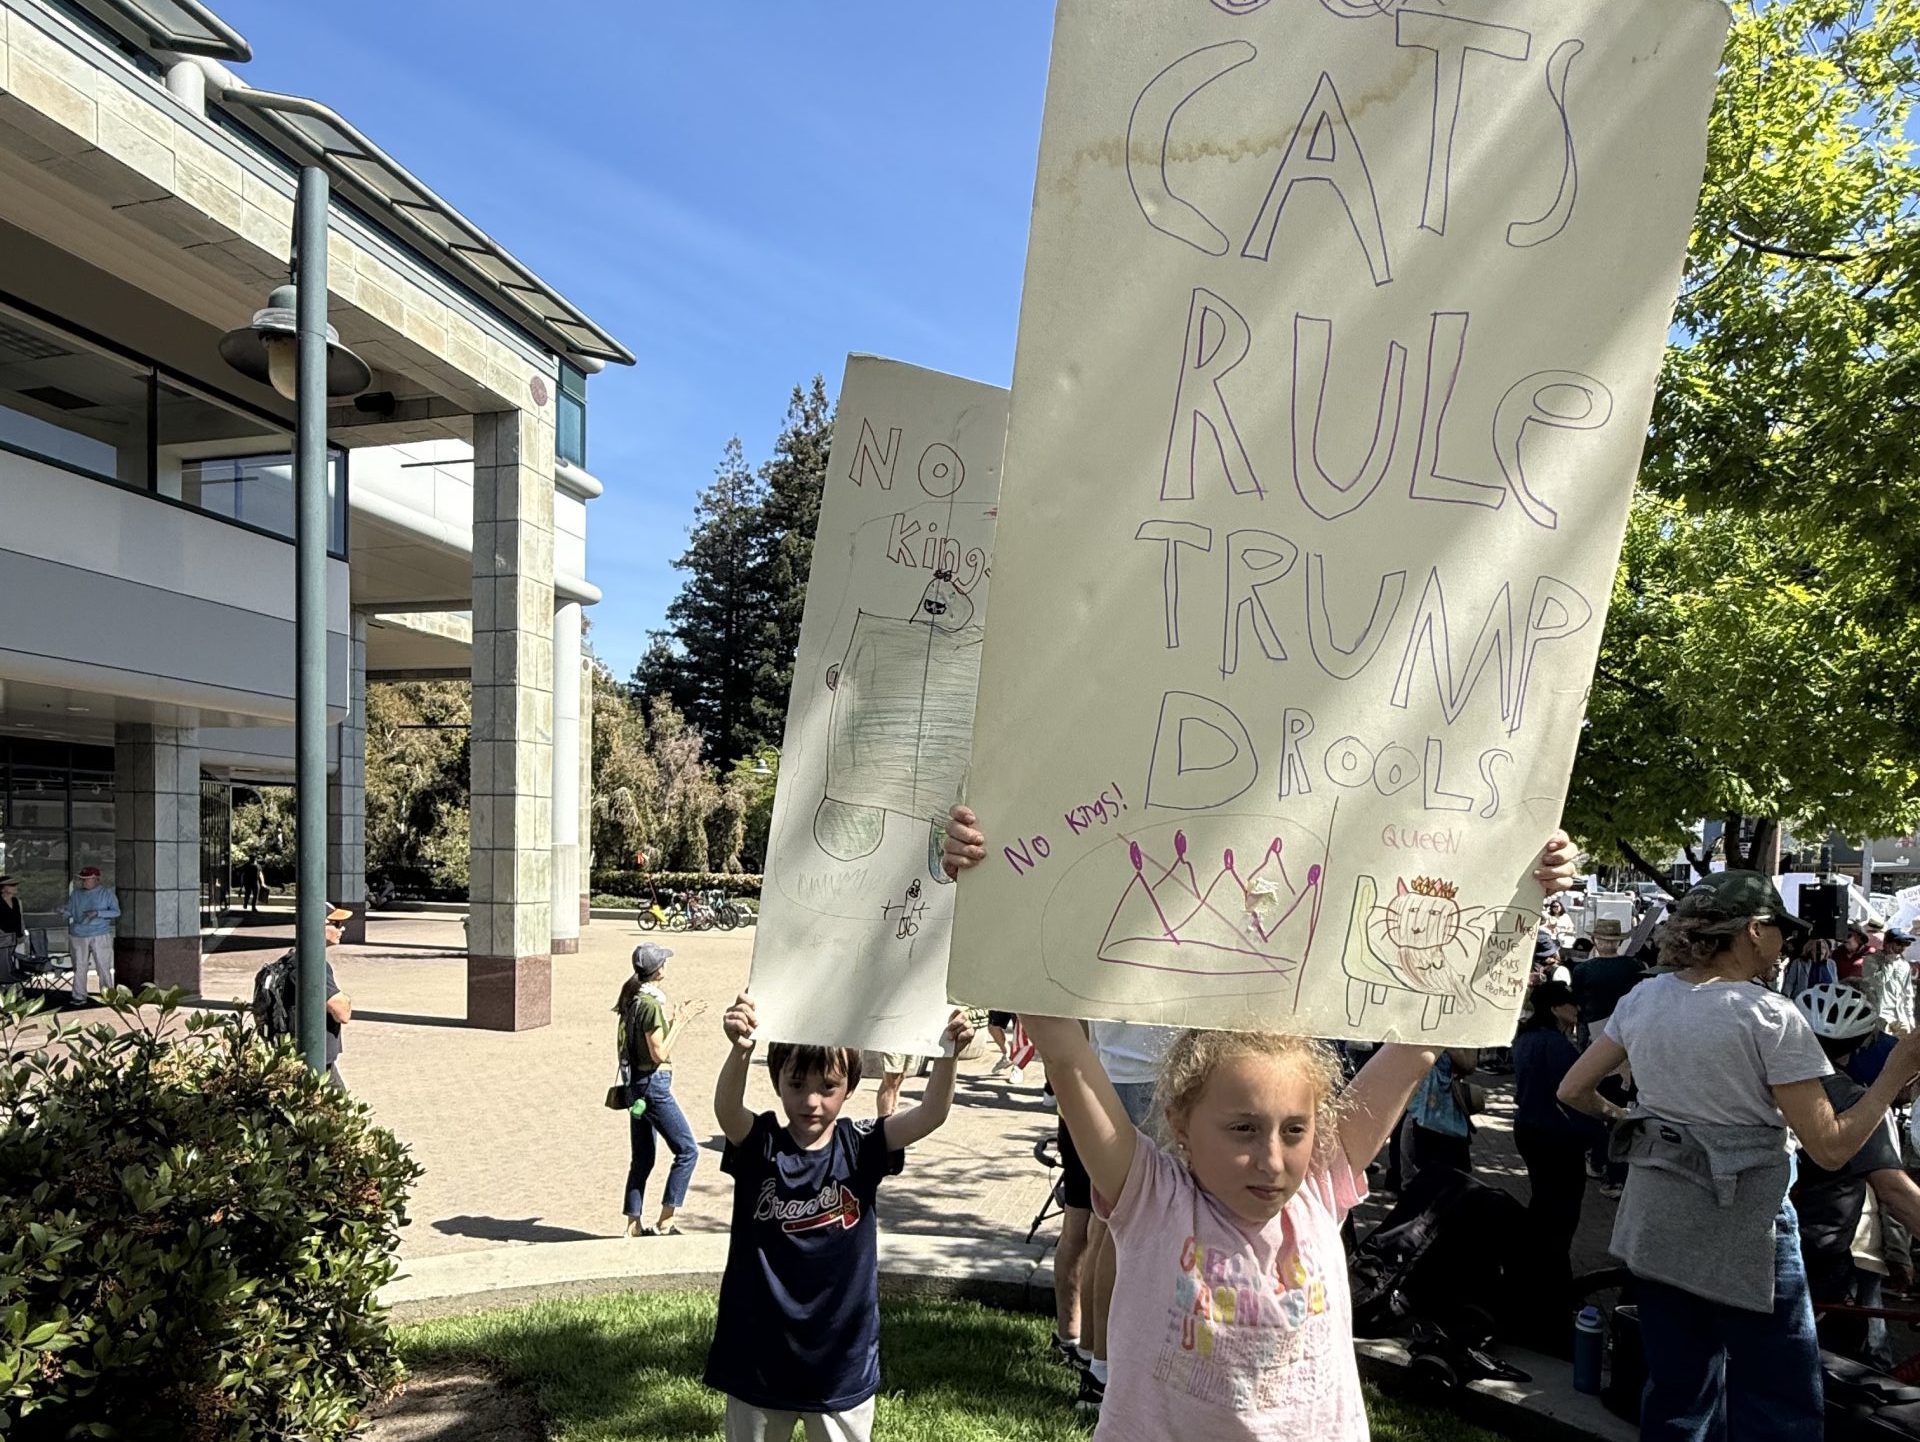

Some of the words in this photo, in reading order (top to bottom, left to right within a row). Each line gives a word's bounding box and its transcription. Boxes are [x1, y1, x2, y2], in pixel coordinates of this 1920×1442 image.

[1126, 8, 1585, 287] CATS
[848, 416, 966, 498] NO
[886, 512, 992, 595] King
[1134, 519, 1593, 738] TRUMP
[1144, 690, 1514, 819] DROOLS
[1487, 910, 1514, 935] I
